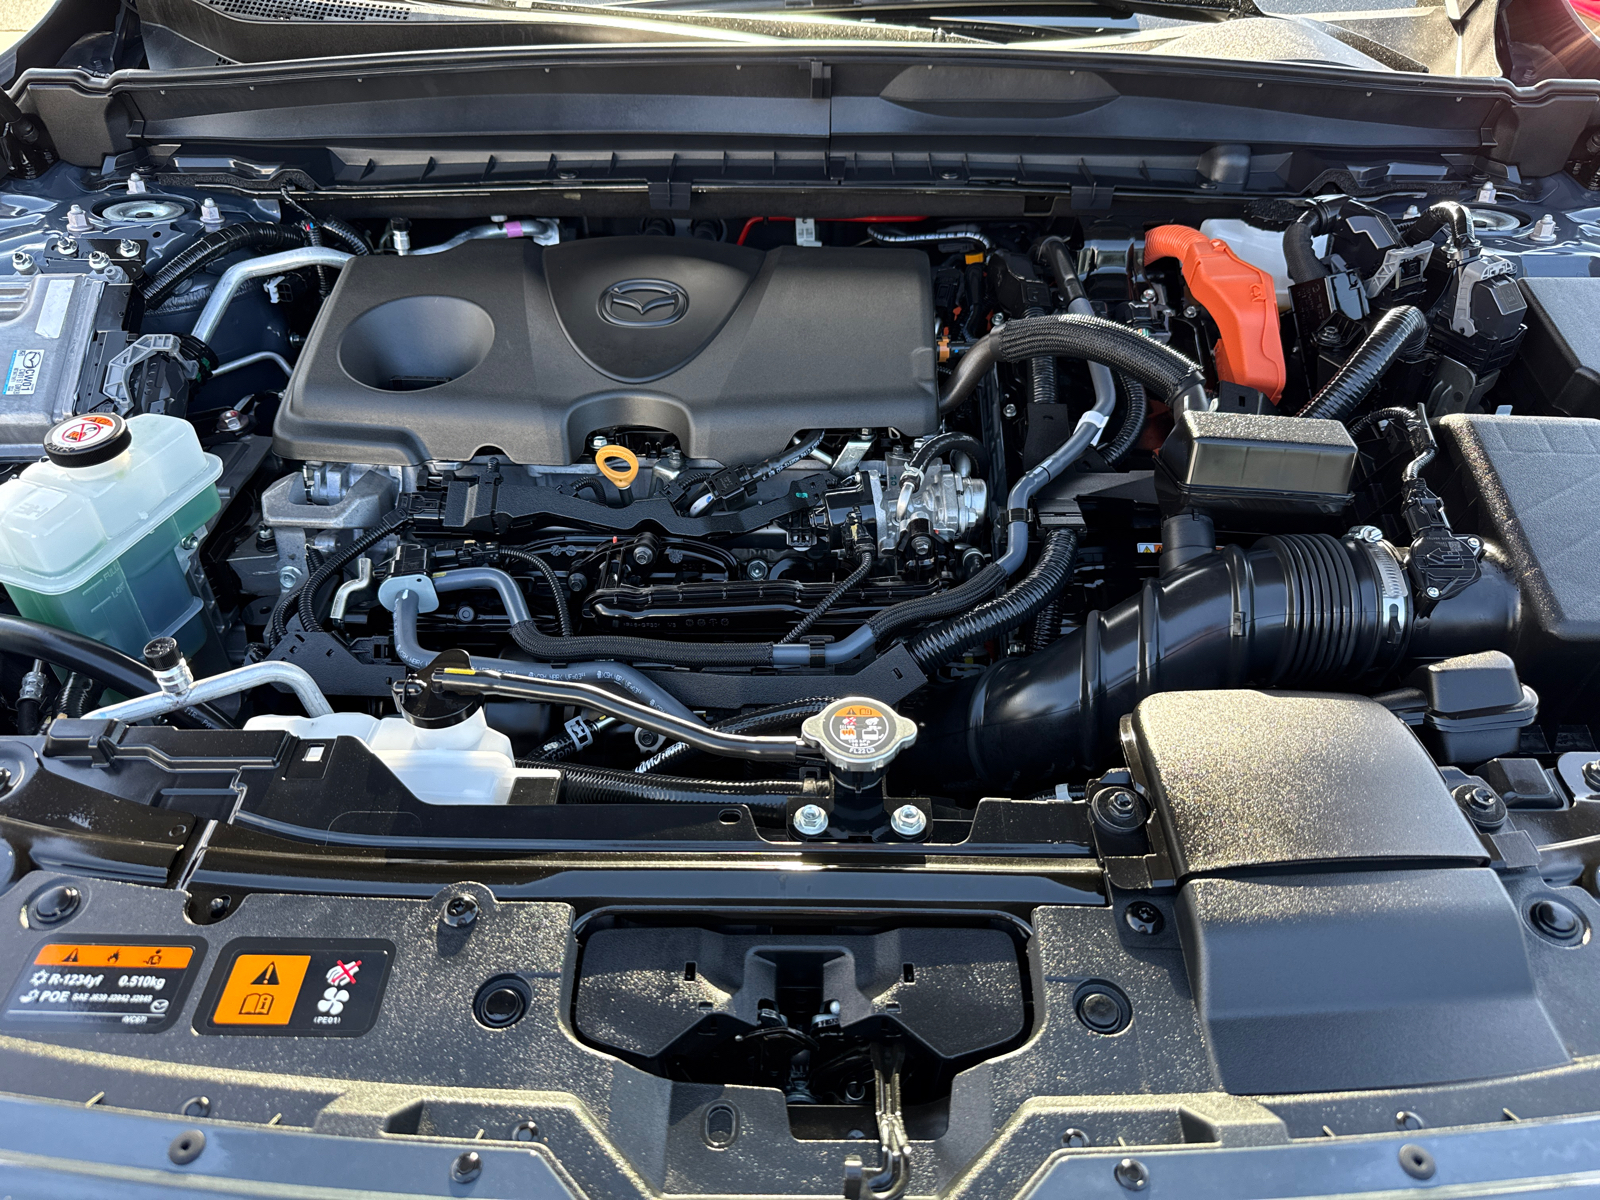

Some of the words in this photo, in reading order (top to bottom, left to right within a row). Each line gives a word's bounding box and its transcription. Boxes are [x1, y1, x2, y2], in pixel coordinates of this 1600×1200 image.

[21, 369, 35, 390] CW01
[103, 564, 120, 581] FULL
[48, 973, 105, 988] R-1234yf
[118, 975, 166, 991] 0.510kg
[39, 991, 70, 1002] POE
[313, 1016, 341, 1025] (PE01)
